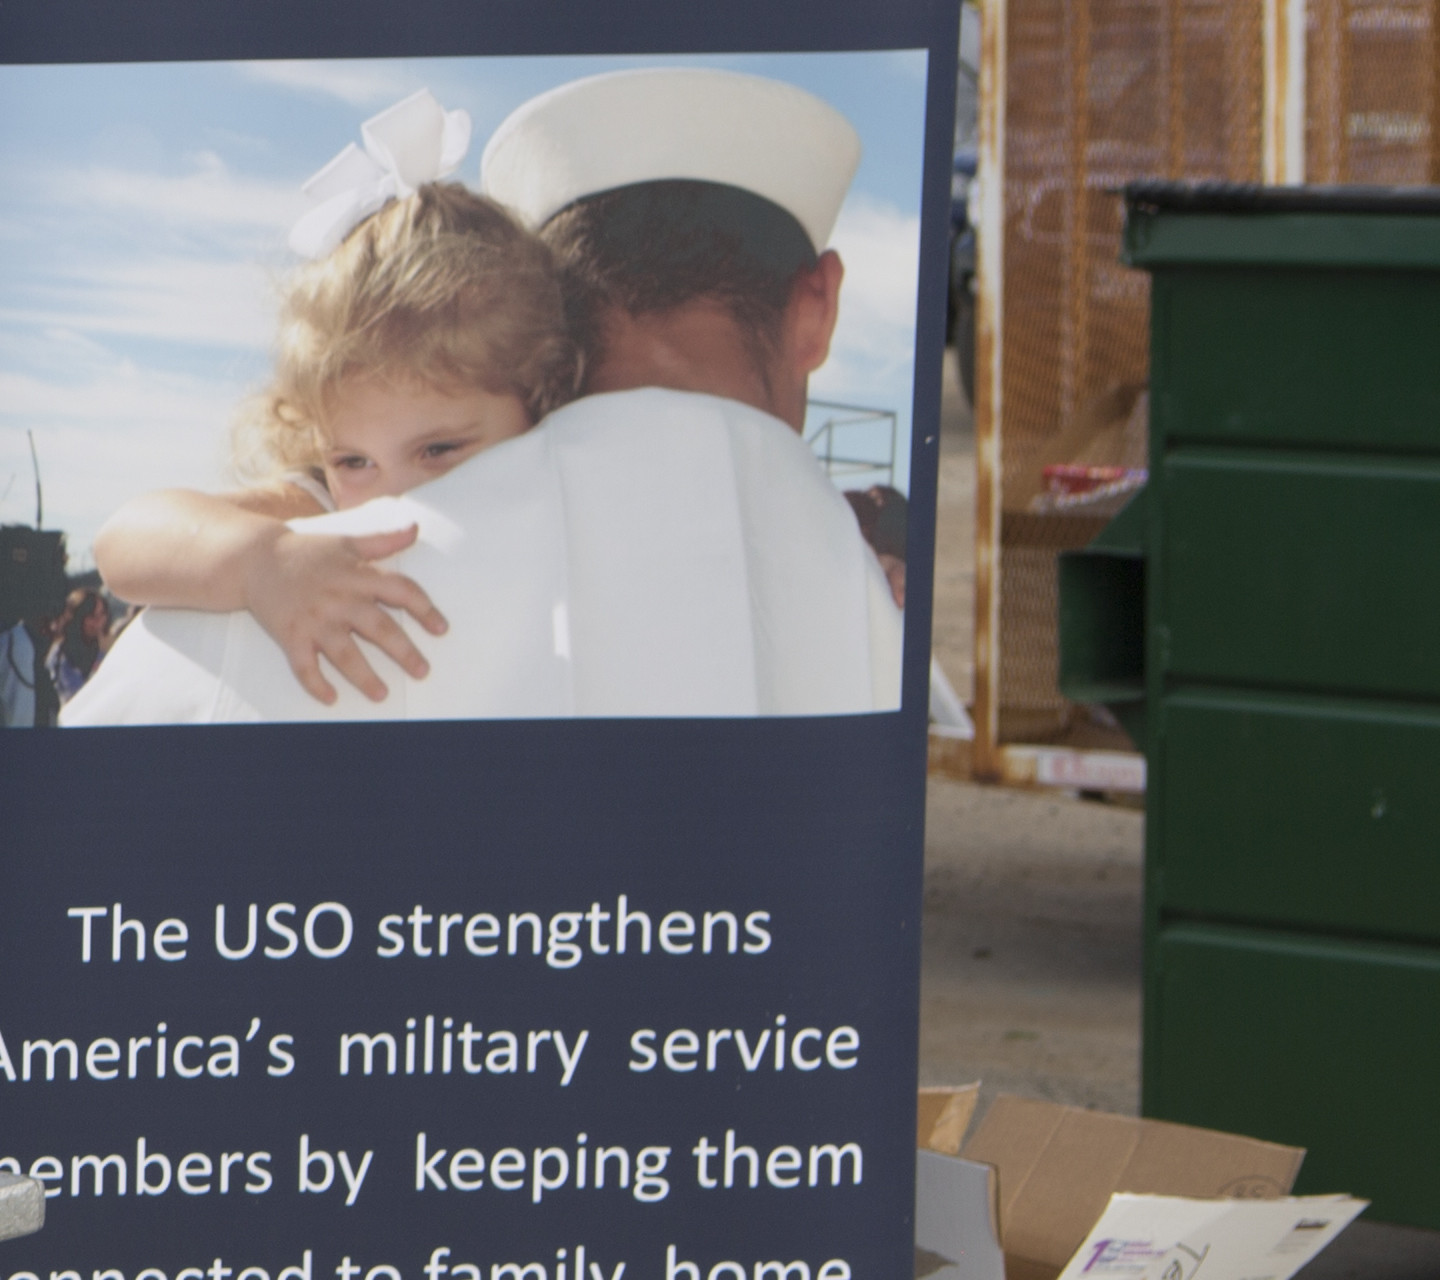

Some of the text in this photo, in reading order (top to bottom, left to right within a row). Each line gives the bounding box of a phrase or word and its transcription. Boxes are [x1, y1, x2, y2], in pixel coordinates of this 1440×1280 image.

[68, 895, 771, 968] The USO strengthens
[340, 1015, 588, 1085] military
[629, 1015, 859, 1071] service
[299, 1134, 373, 1205] by
[416, 1133, 671, 1202] keeping
[693, 1130, 862, 1188] them
